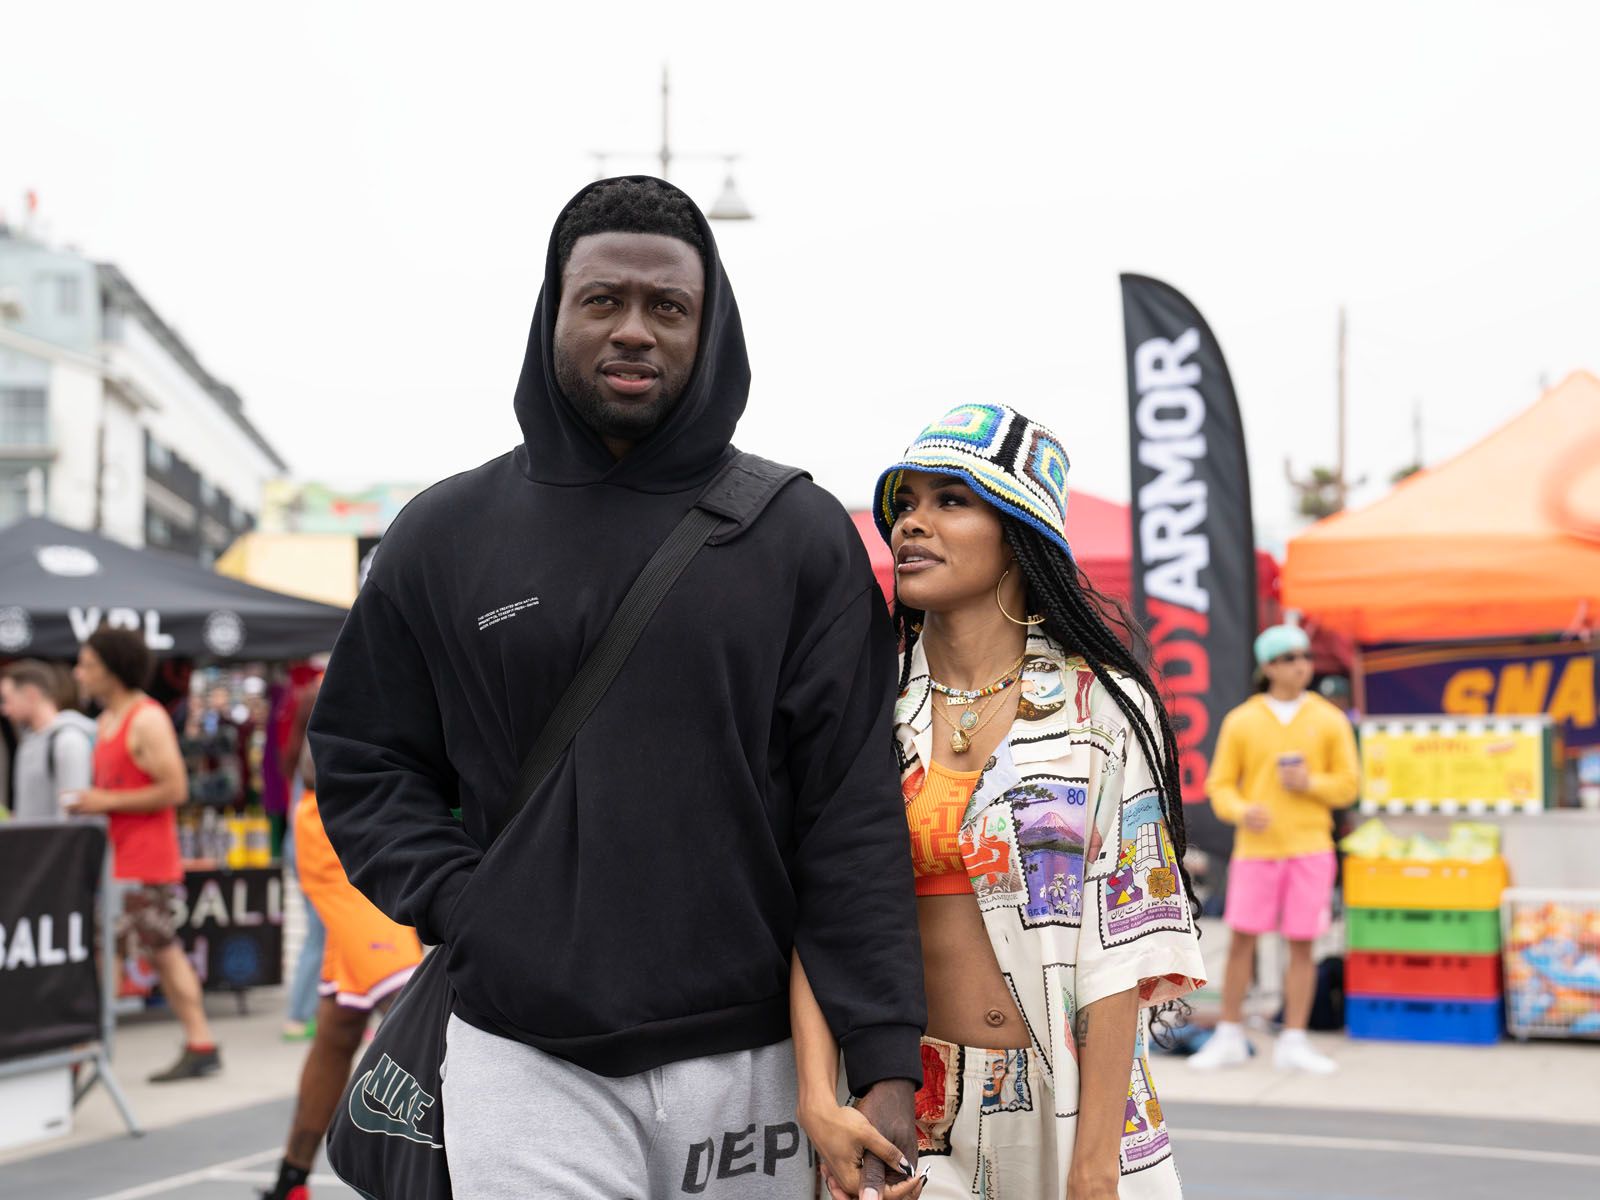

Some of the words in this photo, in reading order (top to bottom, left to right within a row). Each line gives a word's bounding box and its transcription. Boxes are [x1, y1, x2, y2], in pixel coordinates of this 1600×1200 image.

[1442, 656, 1597, 728] SNA
[1066, 788, 1086, 806] 80
[1147, 900, 1178, 908] IRAN
[0, 911, 89, 970] ALL
[364, 1052, 436, 1124] NIKE
[681, 1121, 813, 1194] DEP
